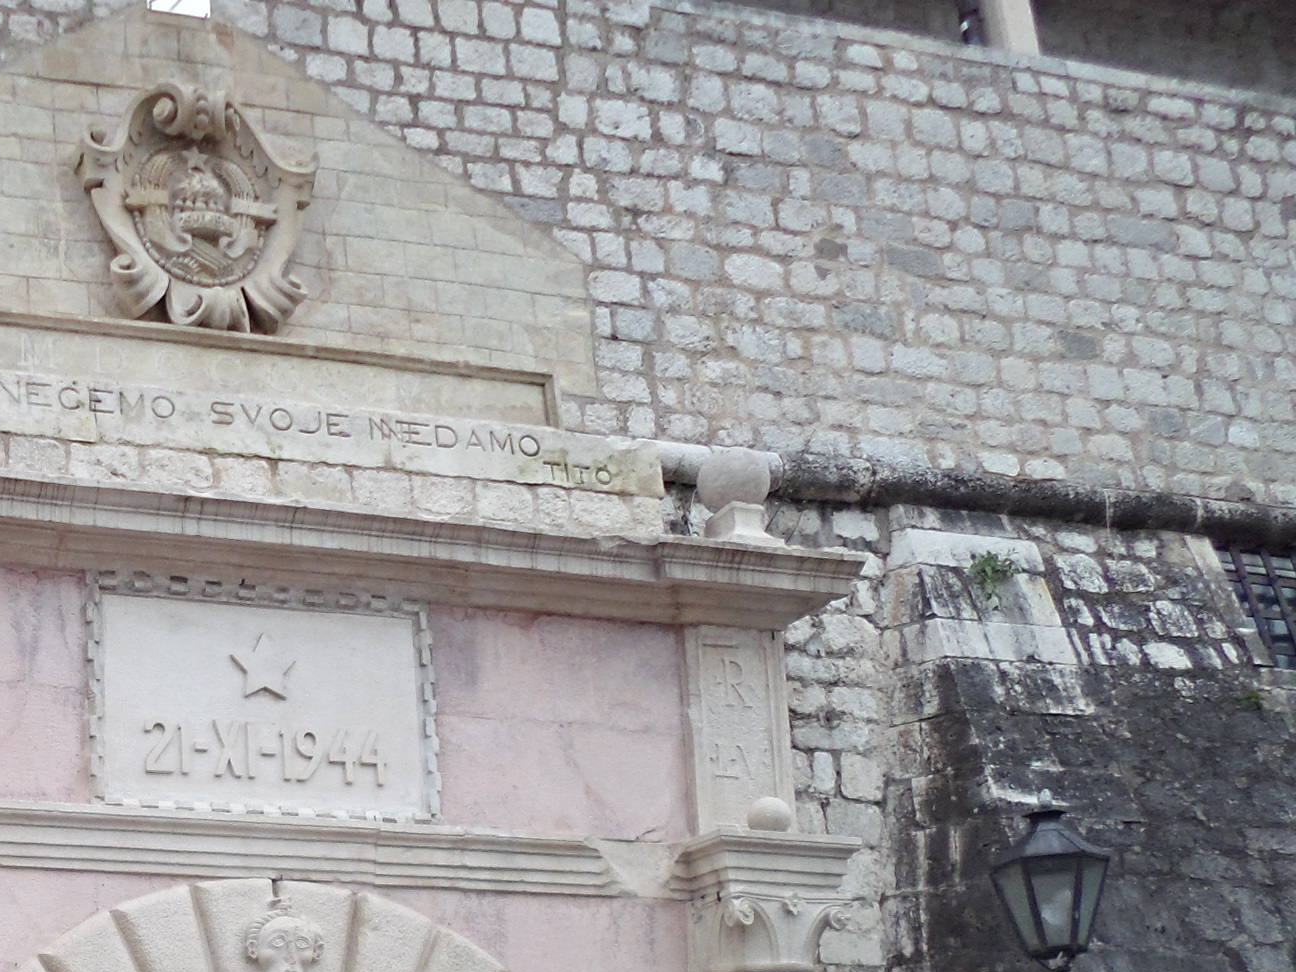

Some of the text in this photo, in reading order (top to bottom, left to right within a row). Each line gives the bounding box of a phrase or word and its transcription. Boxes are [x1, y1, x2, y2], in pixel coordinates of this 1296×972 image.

[210, 401, 352, 438] SVOJE
[368, 417, 542, 458] NEDAMO
[542, 460, 613, 486] TITO
[142, 718, 388, 789] 21-XI-1944
